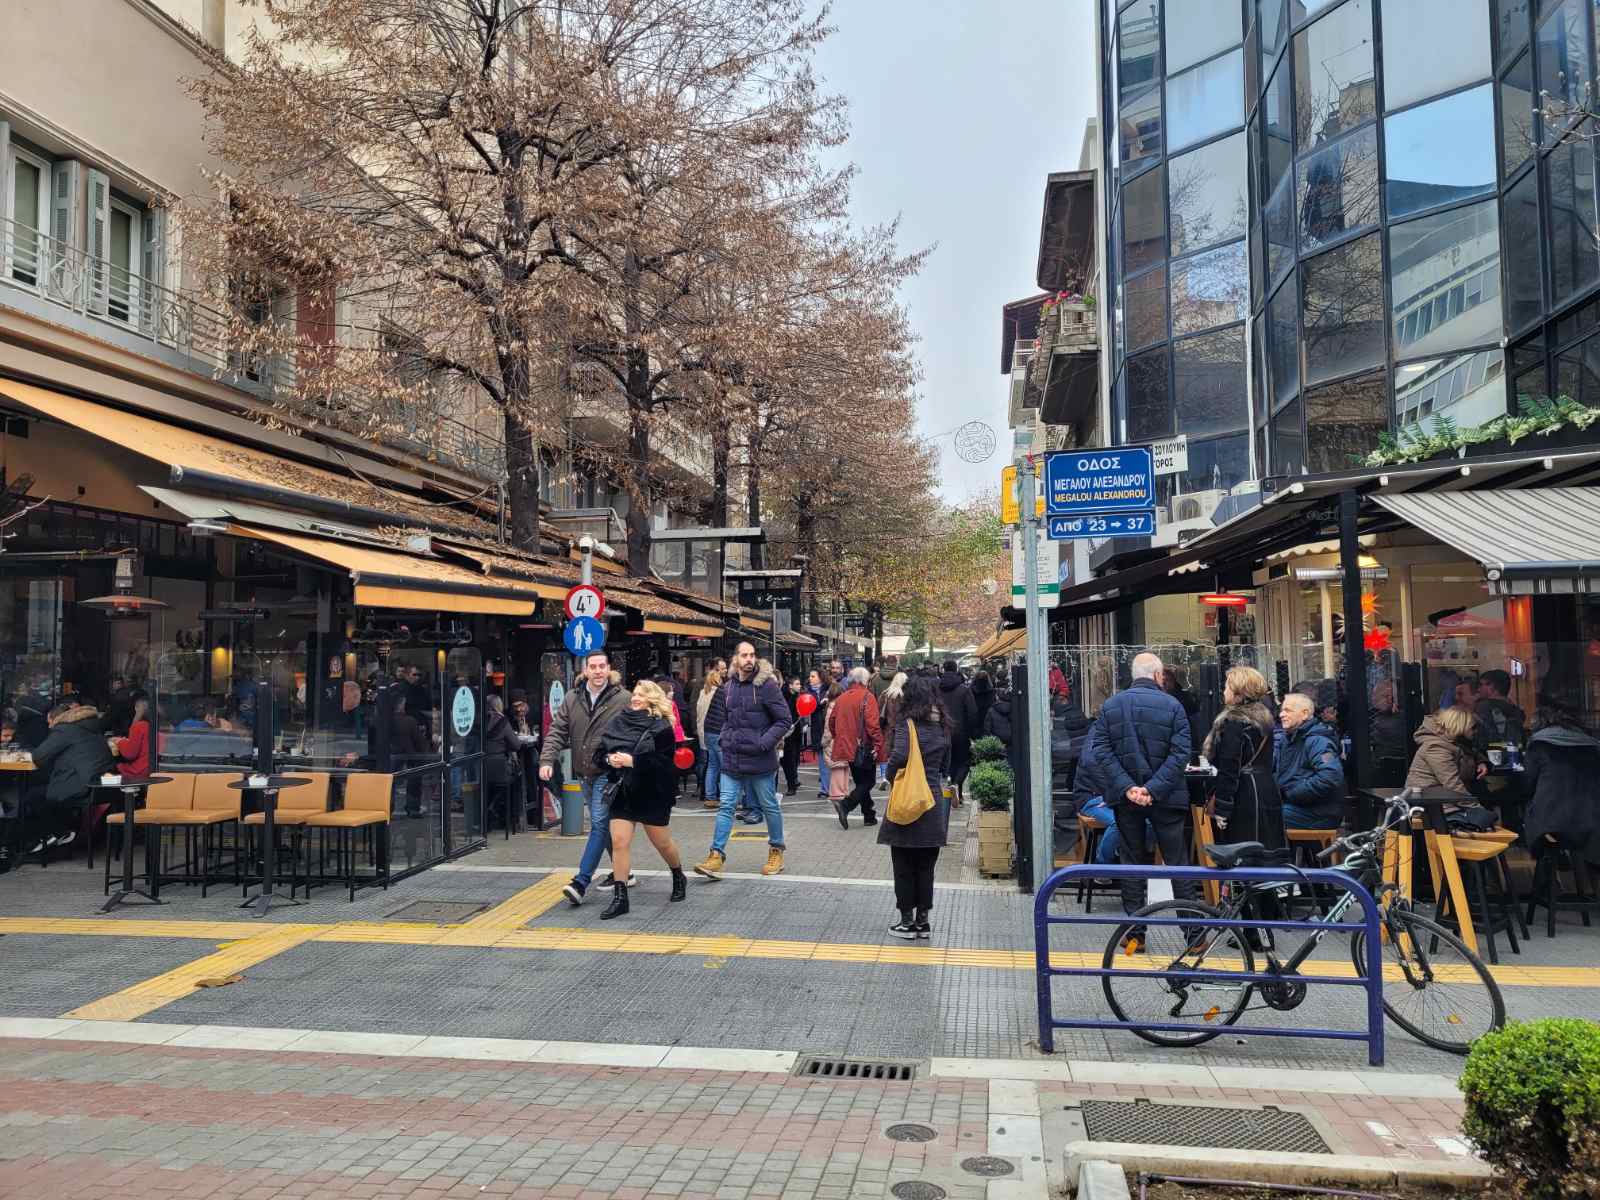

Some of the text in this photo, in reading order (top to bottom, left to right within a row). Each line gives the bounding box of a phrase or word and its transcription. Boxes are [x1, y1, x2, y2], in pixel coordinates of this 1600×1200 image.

[1078, 457, 1120, 471] ΟΔΟΣ
[1153, 457, 1173, 469] ΟΡΟΣ
[1055, 474, 1146, 490] ΜΕΓΑΛΟΥ ΑΛΕΞΑΝΔΡΟΥ
[1055, 489, 1146, 502] MEGALOU ALEXANDROU
[1088, 519, 1106, 531] 23
[1127, 517, 1145, 529] 37
